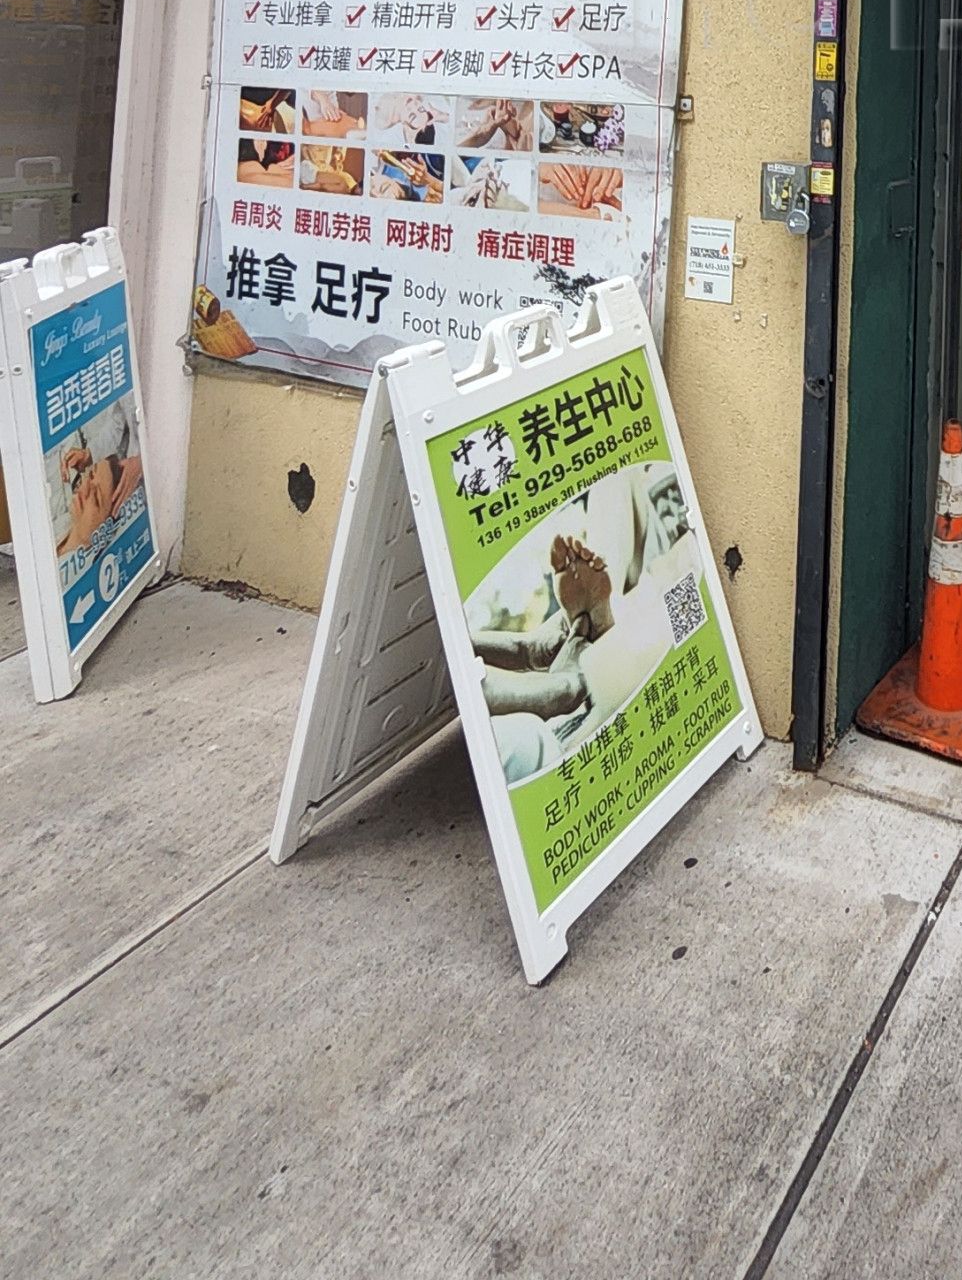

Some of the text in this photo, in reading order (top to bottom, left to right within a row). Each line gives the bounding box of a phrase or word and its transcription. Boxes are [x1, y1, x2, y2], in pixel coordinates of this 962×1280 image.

[263, 1, 627, 31] 专业推拿 精油开背 头疗 足疗
[260, 44, 621, 80] 刮痧 拔罐 采耳 修脚 针灸 SPA
[231, 199, 574, 267] 肩周炎 腰肌劳损 网球肘 痛症调理
[226, 247, 391, 323] 推拿 足疗
[402, 311, 481, 341] Foot Rub
[403, 278, 503, 310] Body work
[450, 420, 509, 465] 中华
[518, 365, 645, 463] 养生中心
[469, 416, 651, 525] Tel: 929-5688-688
[477, 436, 658, 547] 136 19 38ave 3fl Flushing NY 11354
[545, 655, 718, 831] 足疗 刮痧 拔罐 采耳
[557, 646, 699, 780] 专业推拿 精油开背
[543, 679, 730, 867] BODY WORK AROMA FOOT RUB
[552, 697, 731, 884] PEDICURE CUPPING SCRAPING
